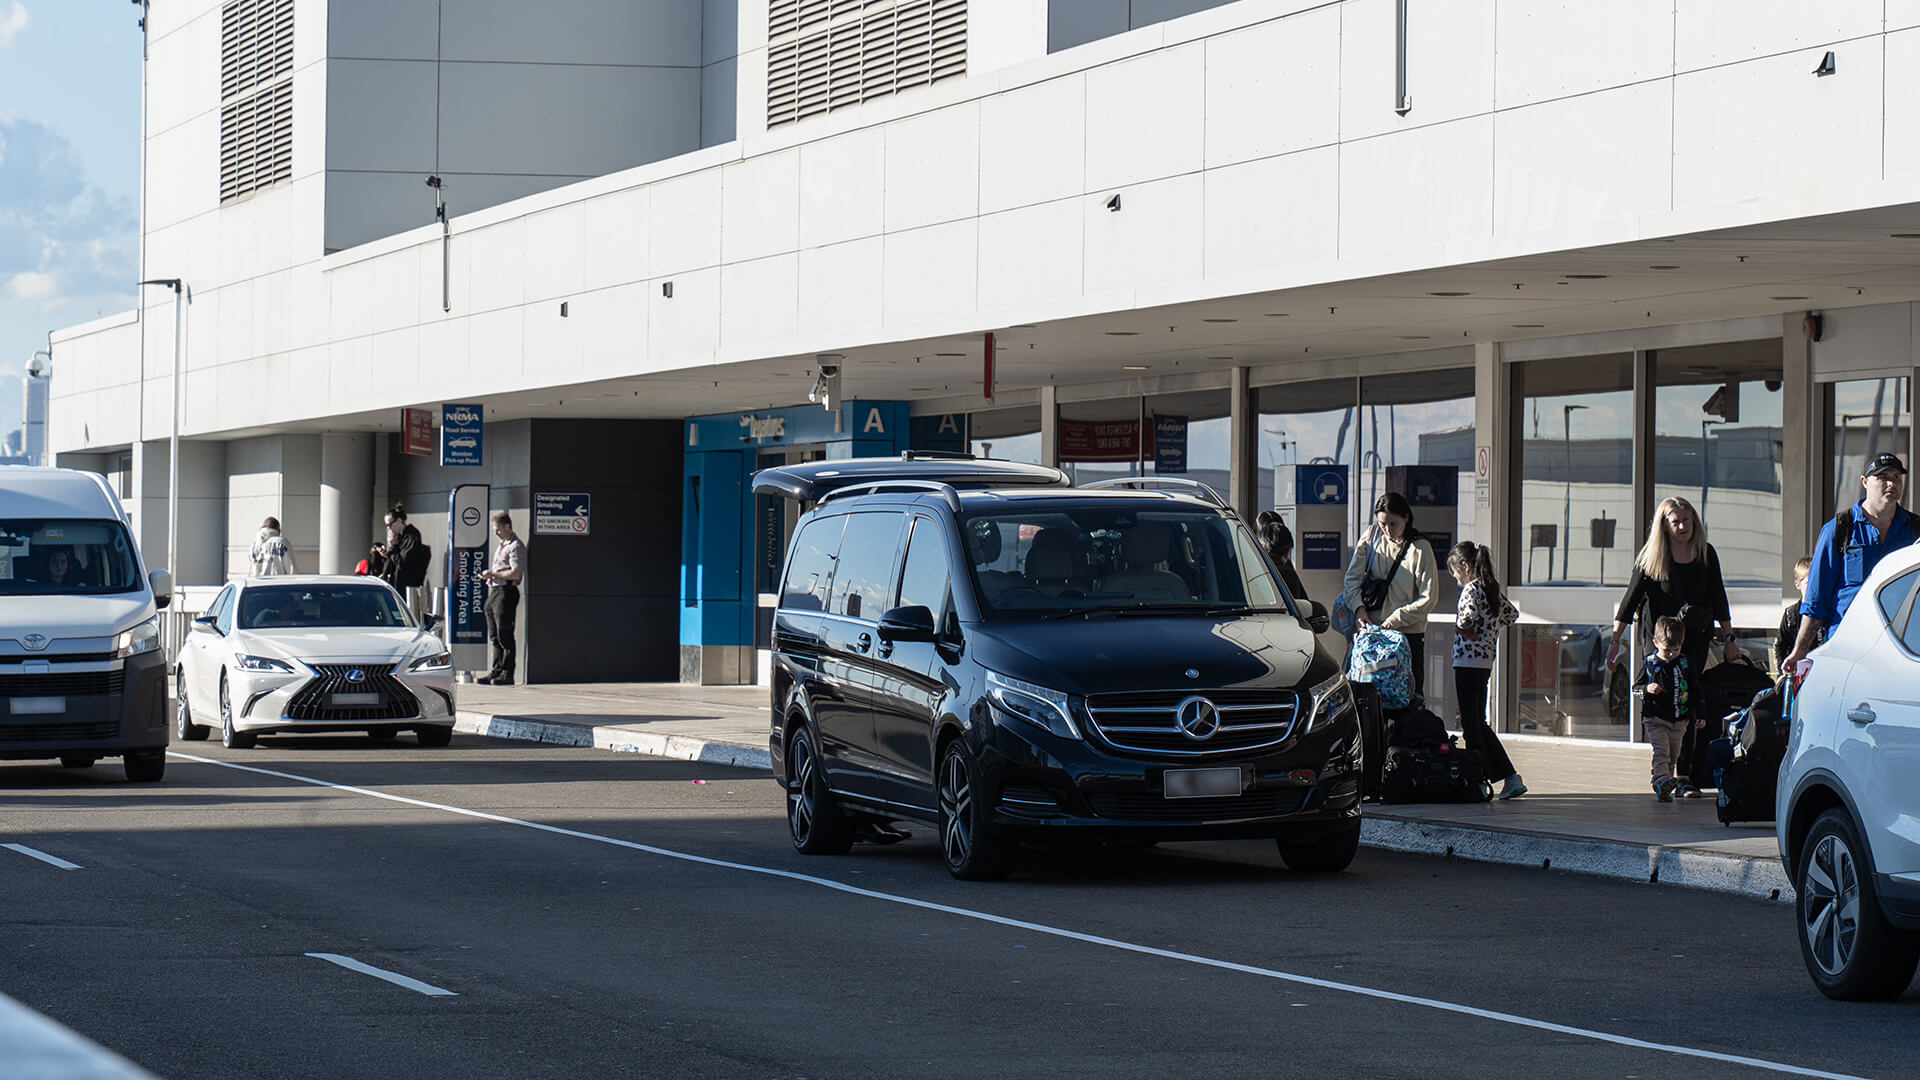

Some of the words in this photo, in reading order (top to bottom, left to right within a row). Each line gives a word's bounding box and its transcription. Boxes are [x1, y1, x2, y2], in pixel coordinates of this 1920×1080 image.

[445, 412, 480, 421] NRMA
[863, 407, 885, 433] A
[456, 551, 470, 597] Smoking
[472, 551, 484, 613] Desgnated
[458, 600, 469, 625] Area
